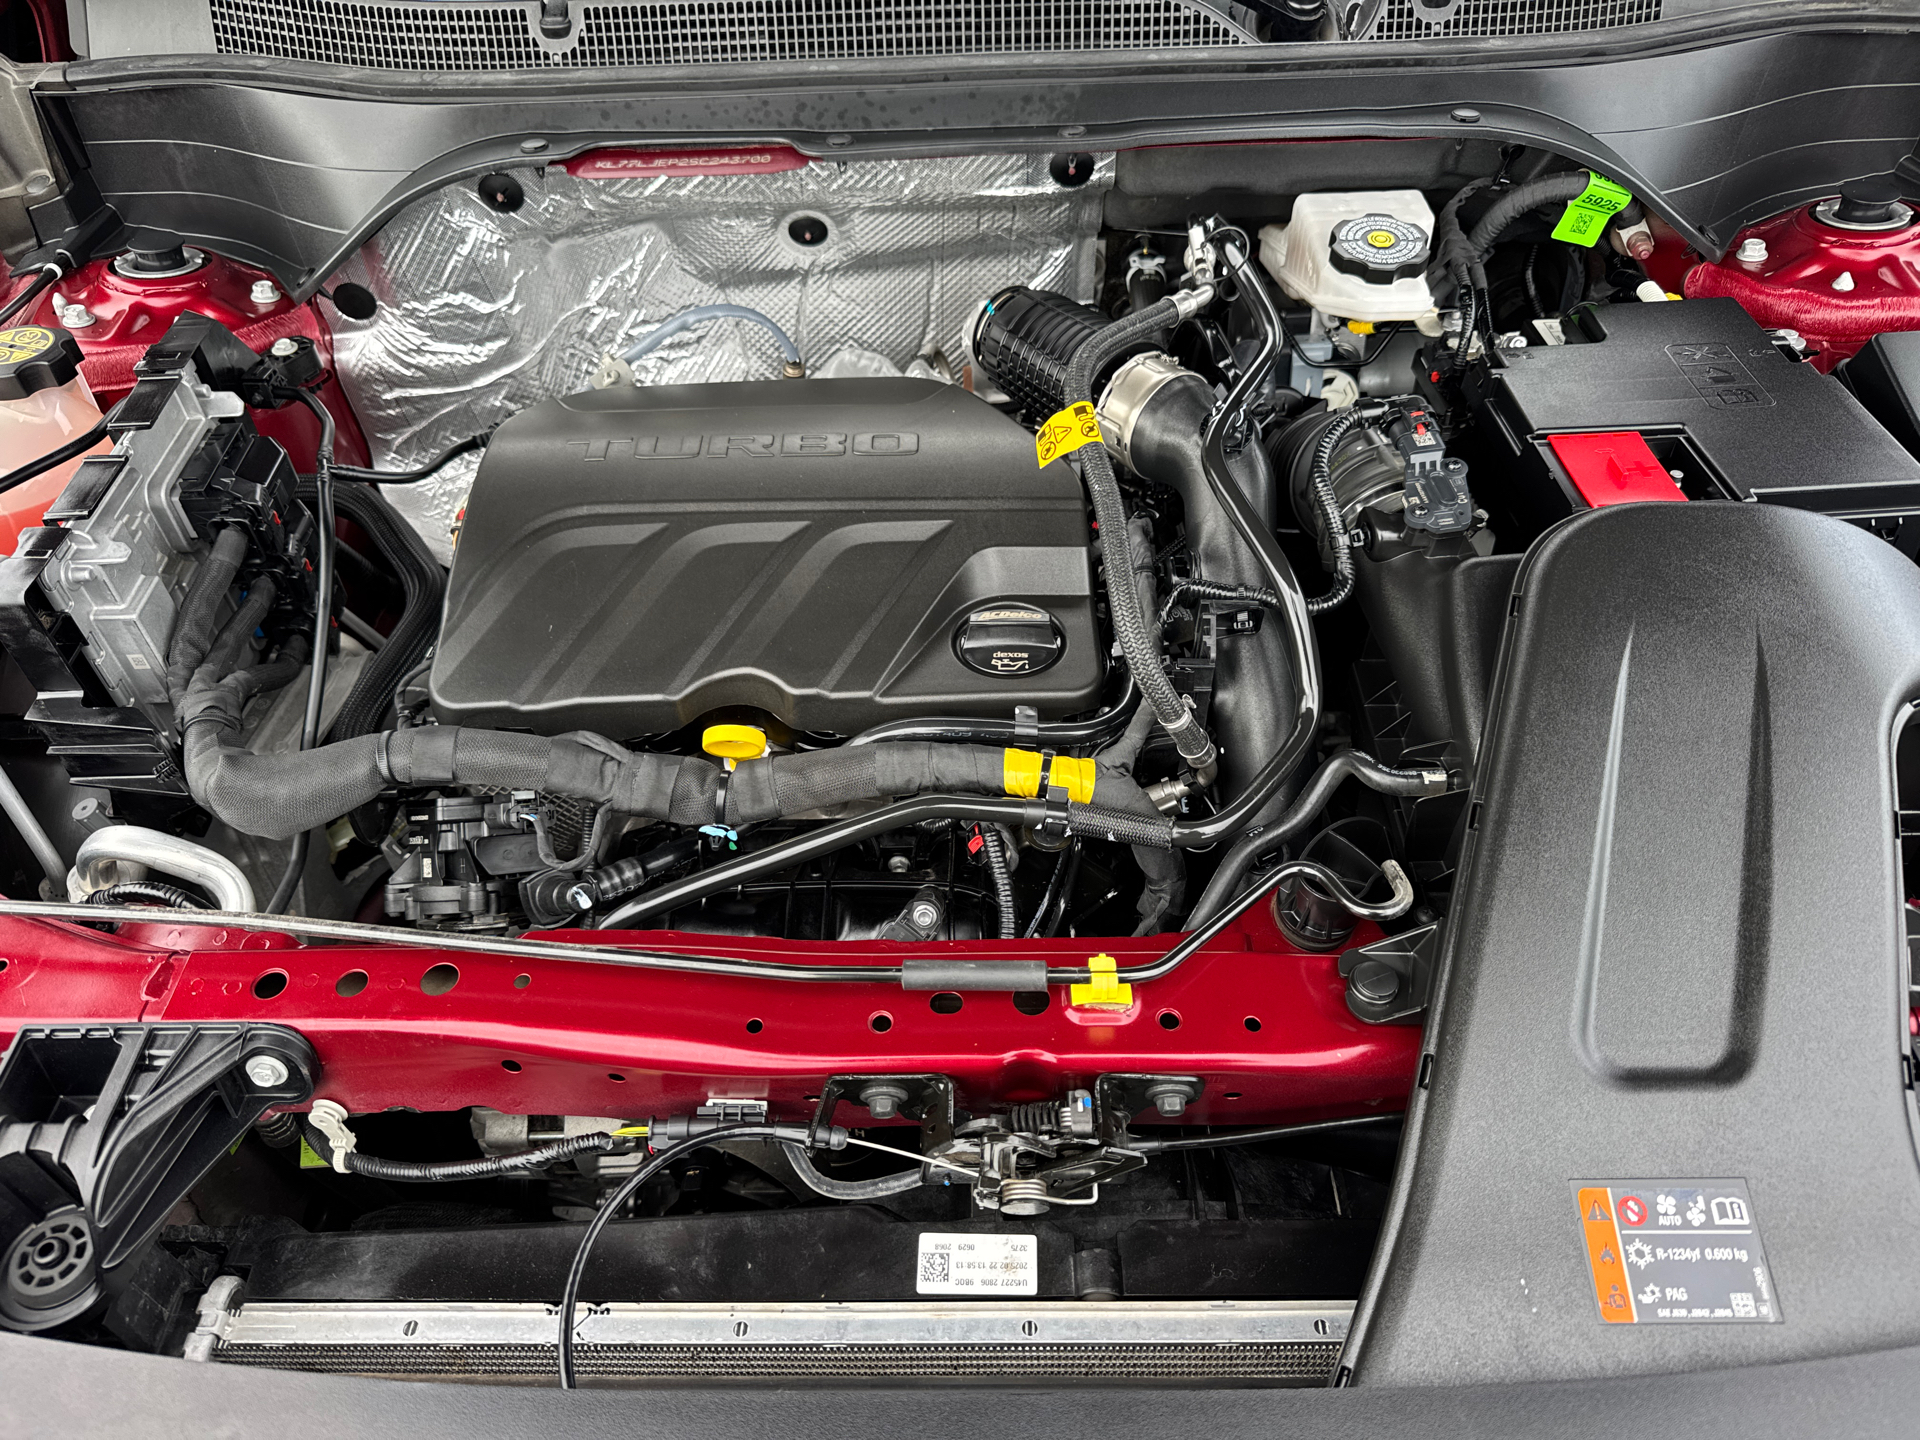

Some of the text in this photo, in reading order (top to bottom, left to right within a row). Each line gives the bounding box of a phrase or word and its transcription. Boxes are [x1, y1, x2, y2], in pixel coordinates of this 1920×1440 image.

[1581, 193, 1622, 212] 5925
[566, 432, 920, 462] TURBO
[977, 611, 1042, 620] ACDelco
[992, 650, 1030, 658] dexos
[1658, 1215, 1682, 1226] AUTO
[934, 1243, 1028, 1252] 3275 0629 2068
[1656, 1248, 1749, 1263] R-1234yf 0.600 kg
[955, 1261, 986, 1269] 13:58:13
[981, 1278, 998, 1286] 2806
[1001, 1278, 1028, 1287] U45227
[1665, 1287, 1688, 1301] PAG
